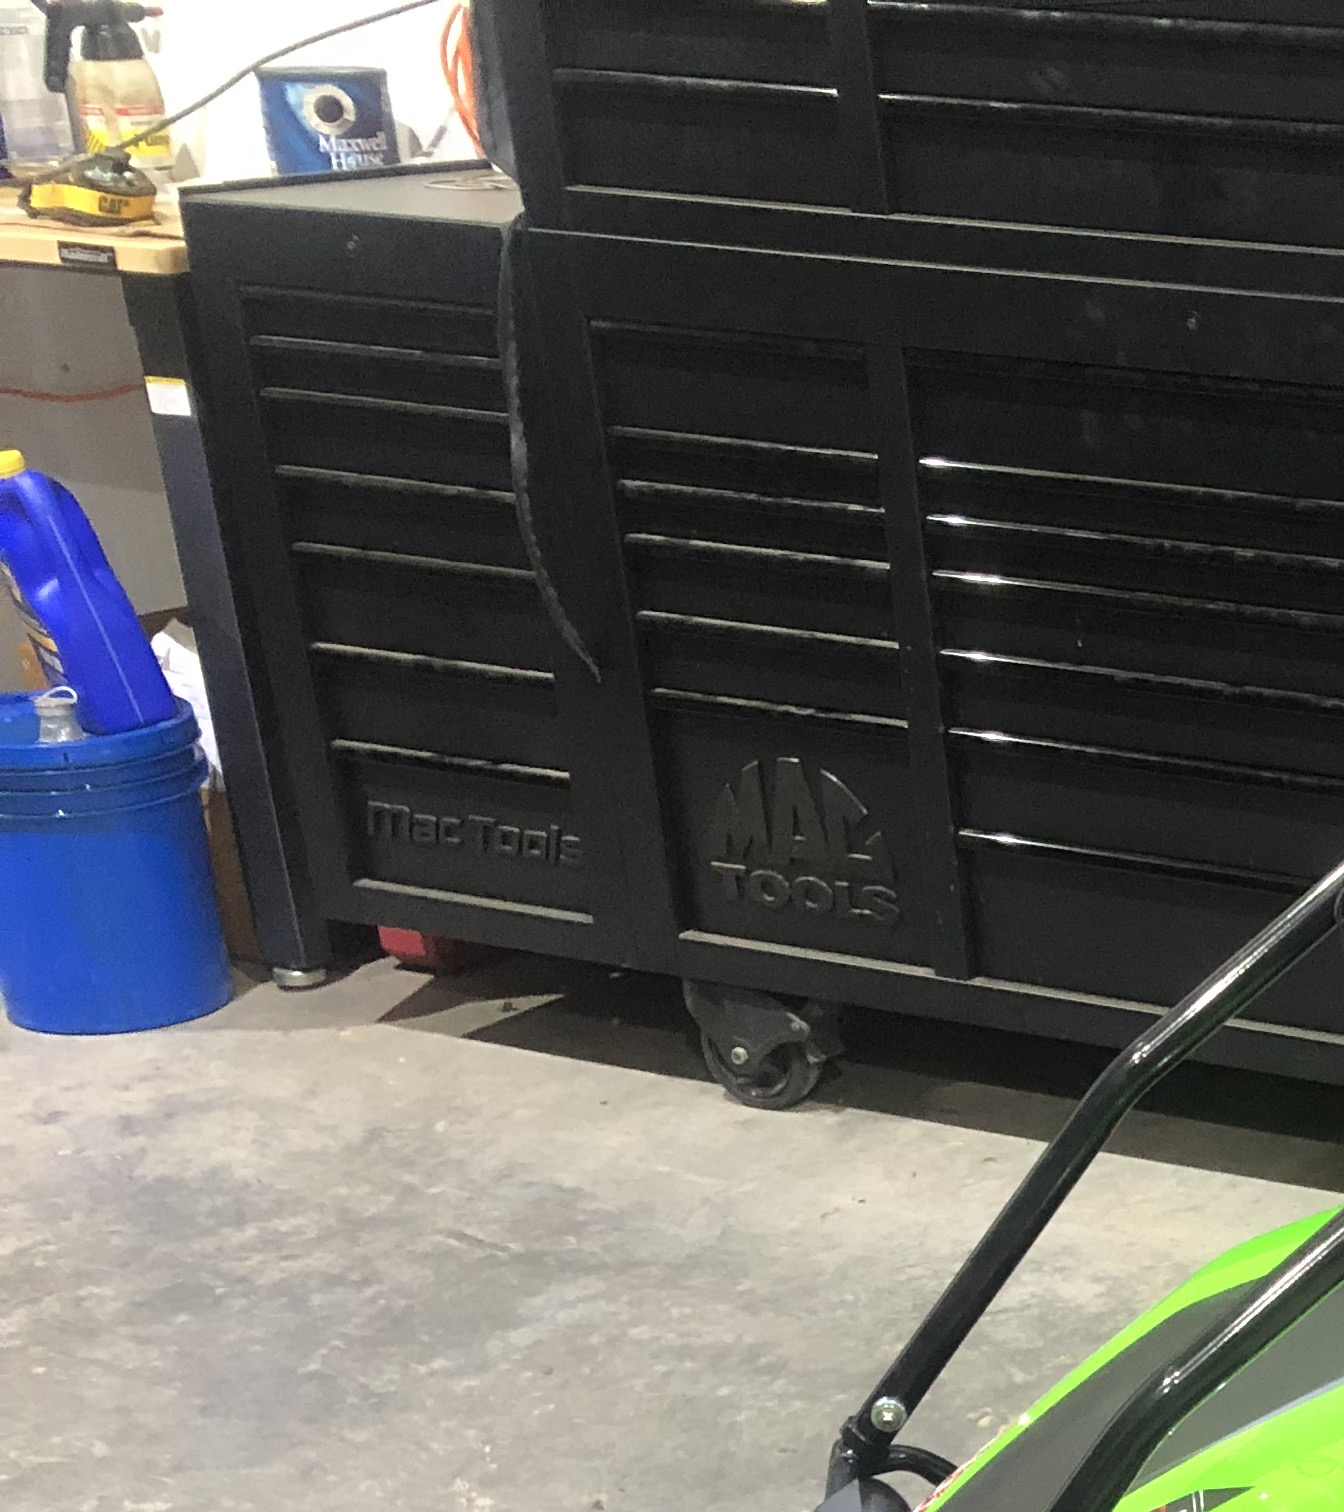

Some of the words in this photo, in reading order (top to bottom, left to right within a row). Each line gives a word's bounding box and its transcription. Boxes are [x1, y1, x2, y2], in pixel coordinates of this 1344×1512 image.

[318, 130, 388, 154] Maxwell
[329, 151, 385, 171] House
[697, 755, 899, 882] MAC
[709, 860, 901, 926] TOOLS
